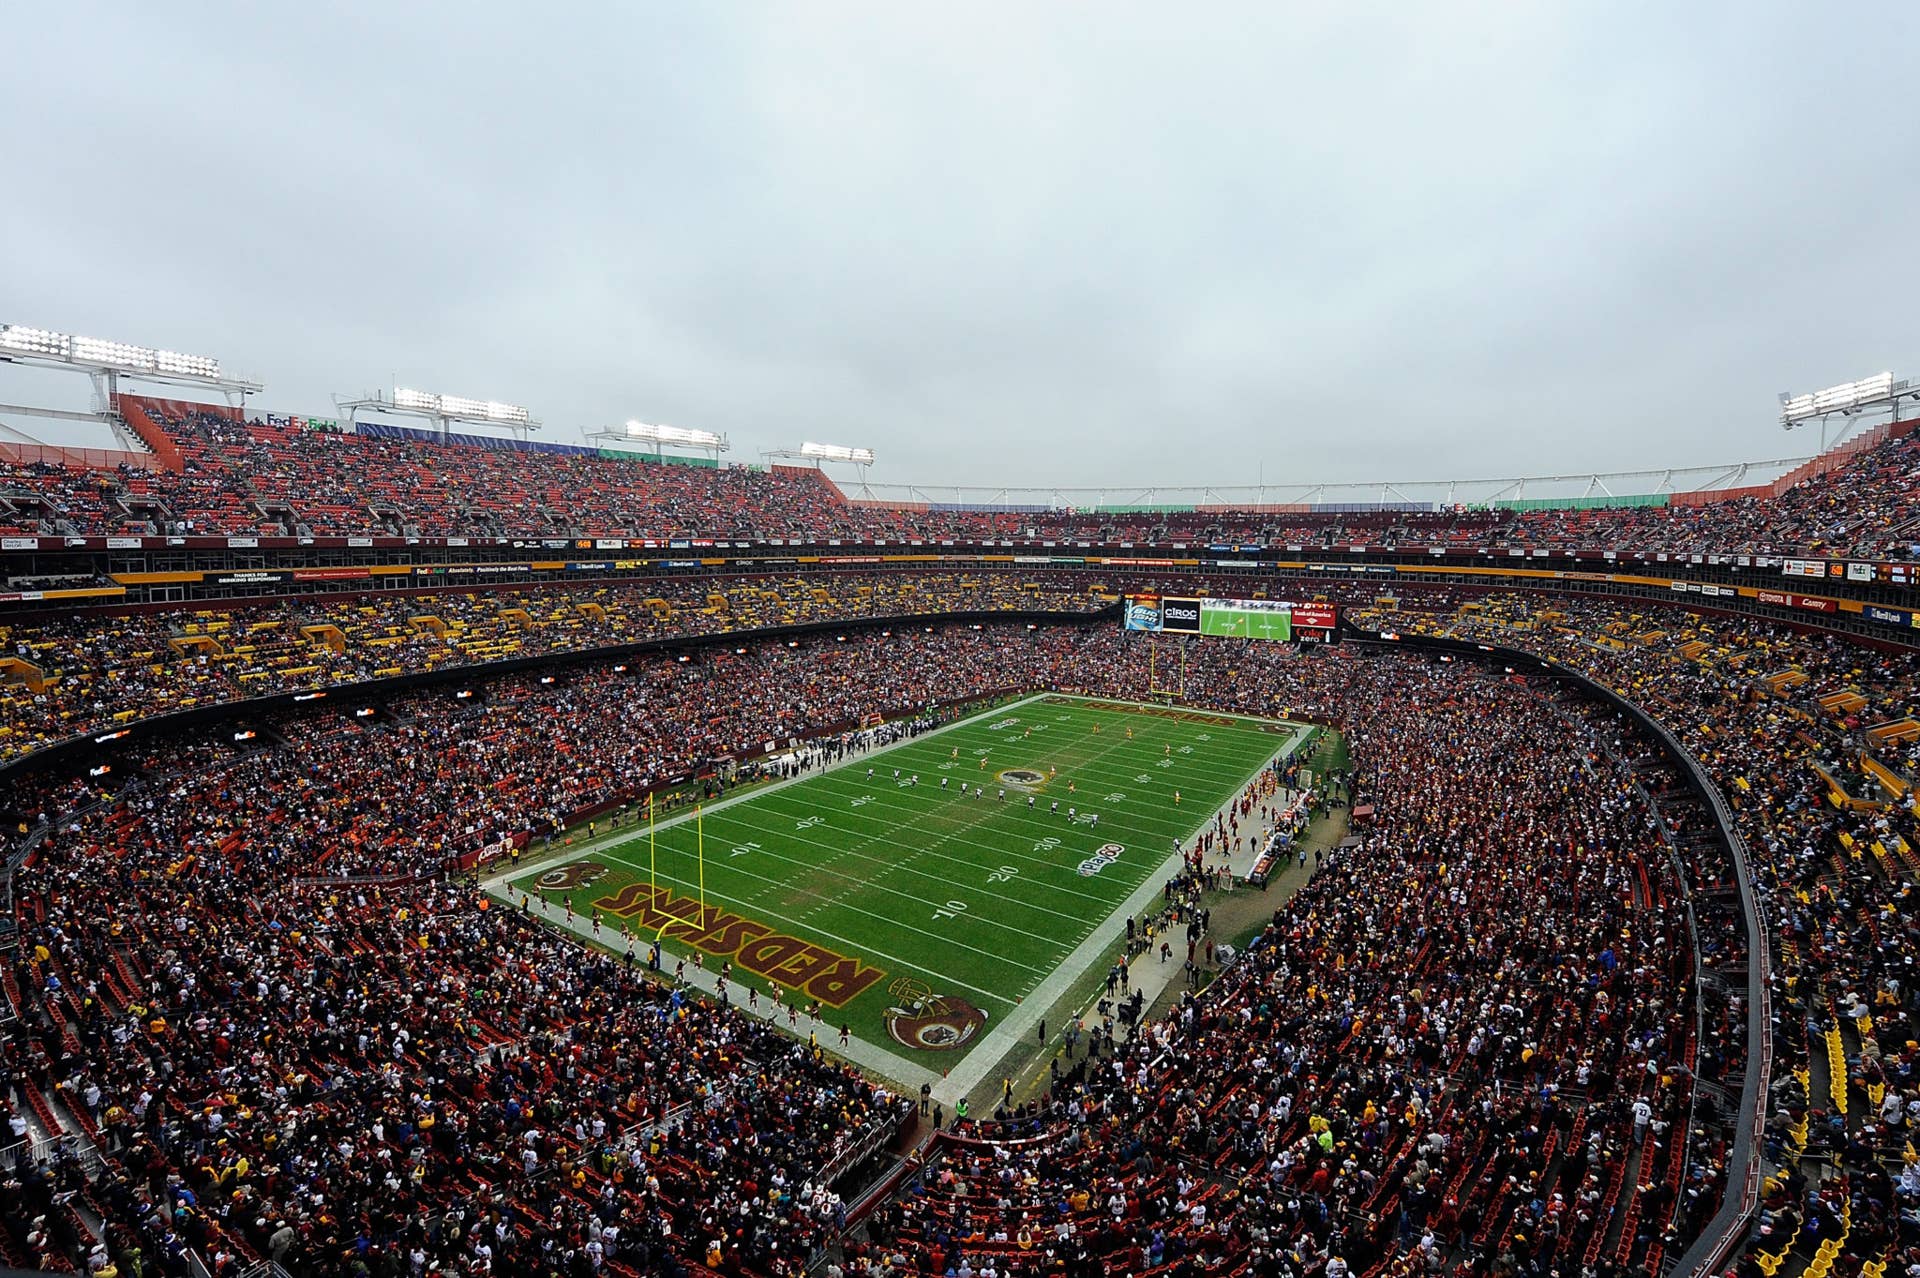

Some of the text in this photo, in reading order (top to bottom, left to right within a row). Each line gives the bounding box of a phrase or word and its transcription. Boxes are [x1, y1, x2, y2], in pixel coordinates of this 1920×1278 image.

[1128, 613, 1159, 623] LIGHT
[1133, 607, 1158, 617] BUD
[1295, 627, 1325, 637] Coke
[796, 816, 825, 830] 20
[989, 865, 1019, 882] 20
[936, 900, 968, 919] 10
[590, 883, 888, 1009] REDSKINS
